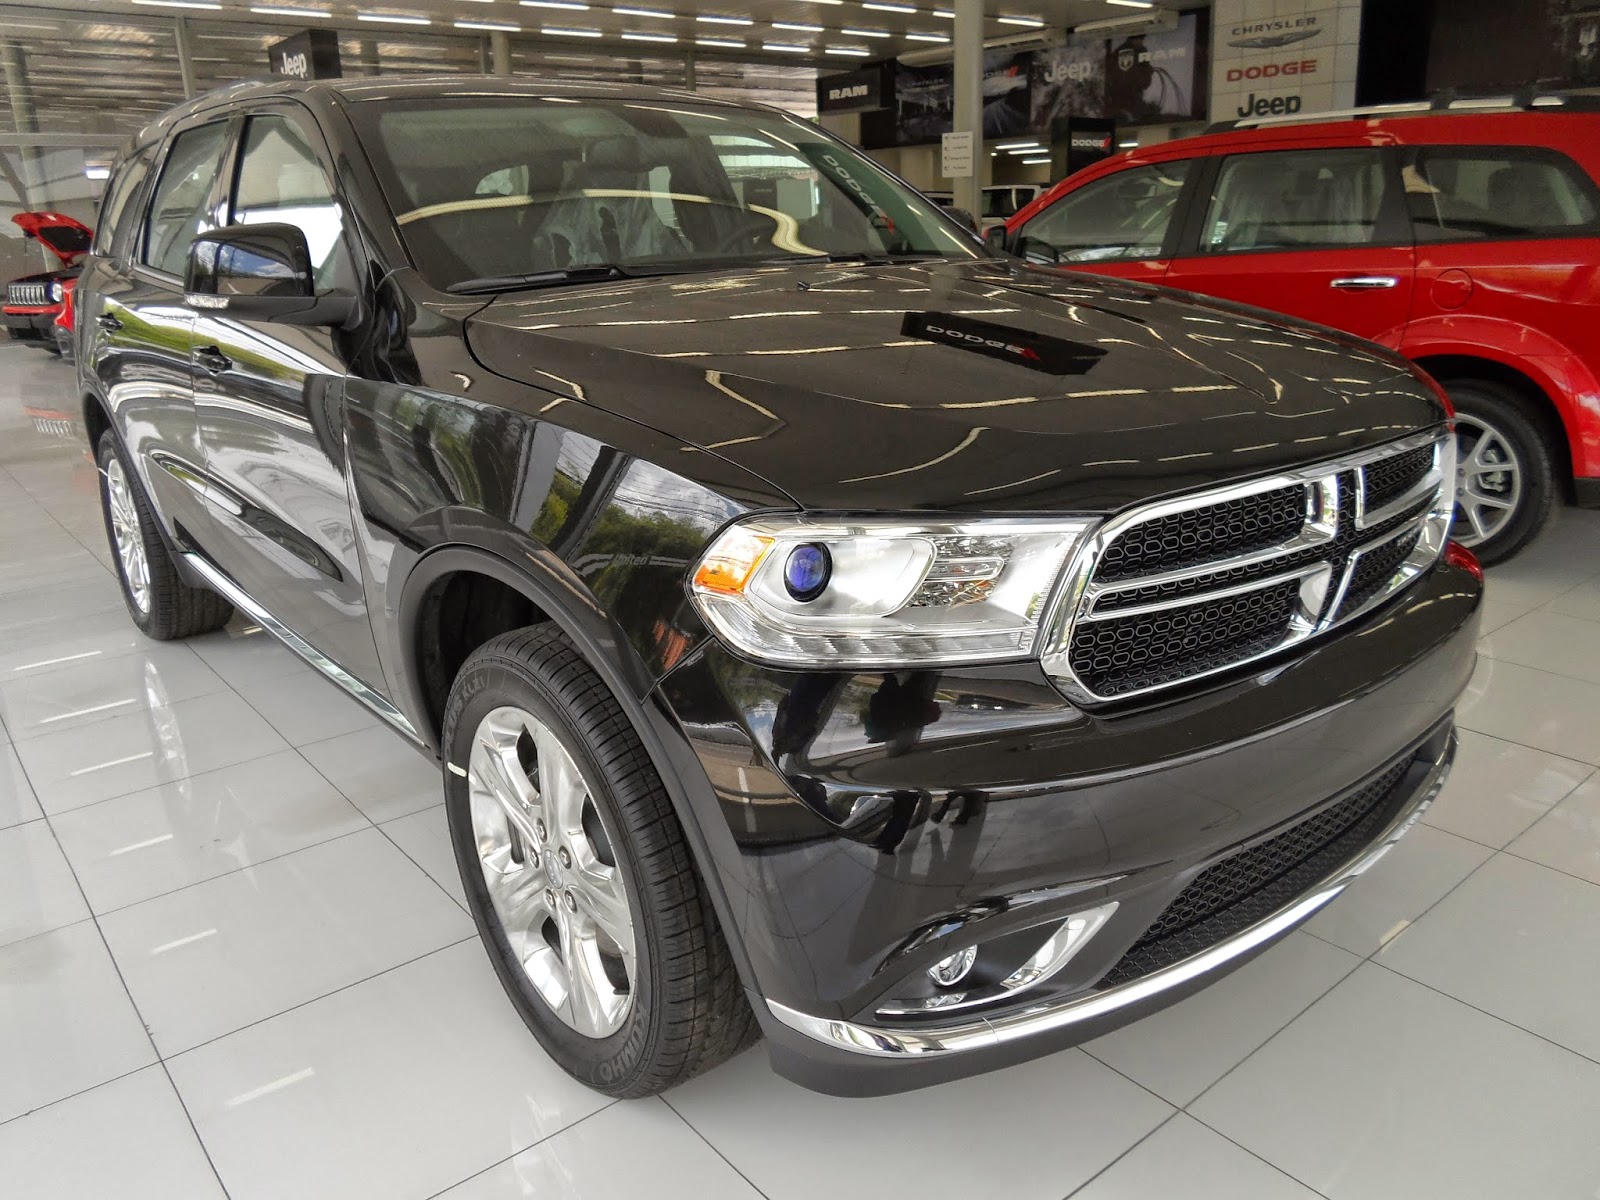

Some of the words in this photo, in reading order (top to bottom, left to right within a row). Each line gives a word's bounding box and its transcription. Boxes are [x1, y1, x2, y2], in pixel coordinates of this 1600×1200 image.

[1231, 17, 1317, 36] CHRYSLER
[280, 52, 307, 79] Jeep
[1044, 61, 1091, 83] Jeep
[1226, 59, 1317, 82] DODGE
[829, 84, 868, 100] RAM
[1237, 93, 1302, 118] Jeep
[1071, 138, 1105, 148] DODGE
[925, 325, 1026, 355] DODGE
